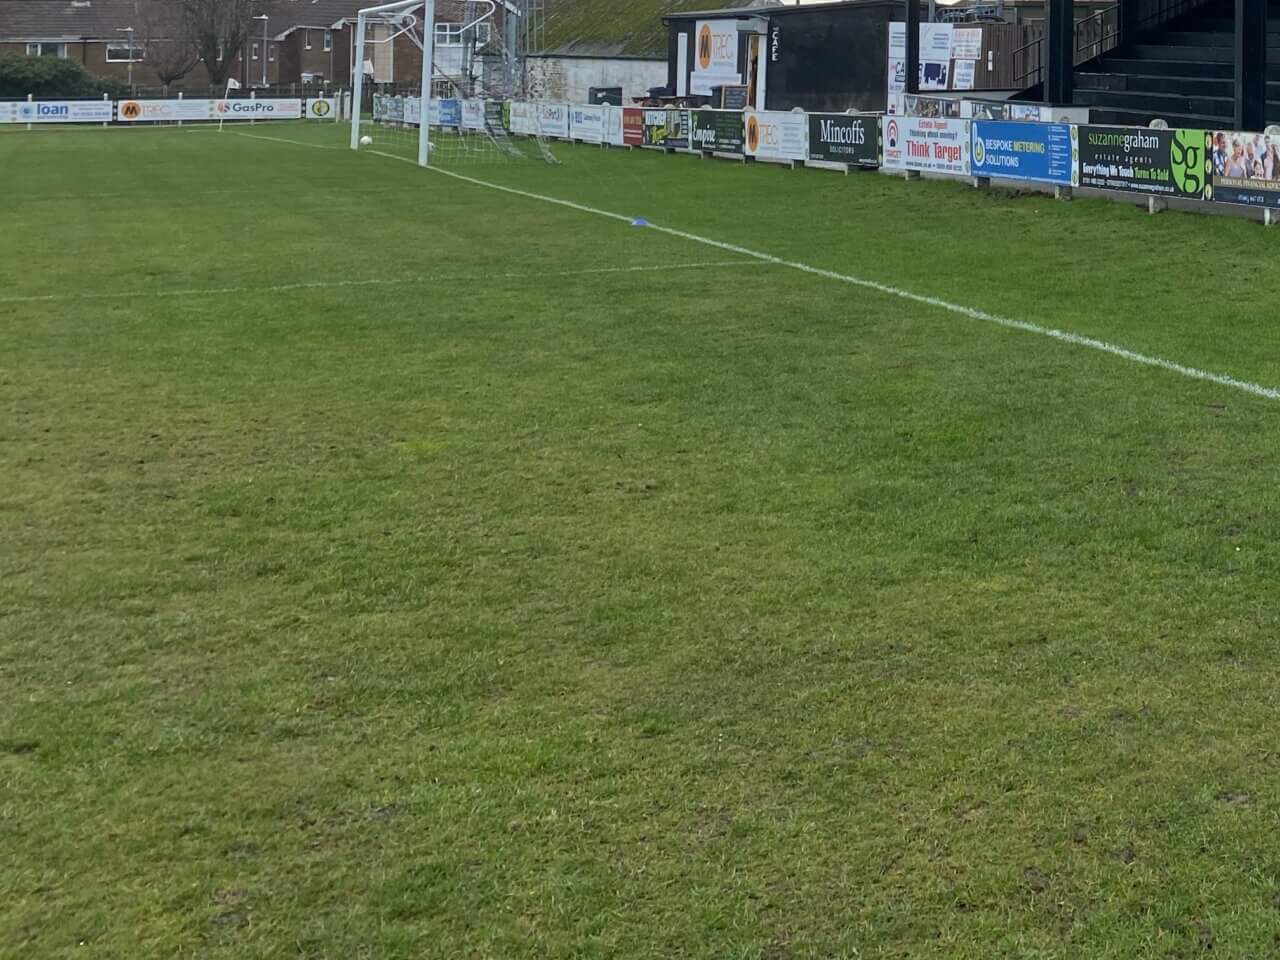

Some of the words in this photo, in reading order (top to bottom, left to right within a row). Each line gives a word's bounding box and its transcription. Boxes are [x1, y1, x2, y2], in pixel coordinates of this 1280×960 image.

[771, 31, 780, 62] CAFE
[36, 103, 69, 115] loan
[232, 102, 275, 113] GasPro
[819, 119, 865, 145] Mincoffs
[905, 140, 930, 158] Think
[932, 141, 962, 163] Target
[985, 138, 1013, 152] BESPOKE
[985, 154, 1020, 168] SOLUTIONS
[1094, 153, 1120, 161] estate
[1125, 156, 1152, 165] agents
[1082, 161, 1110, 178] Everything
